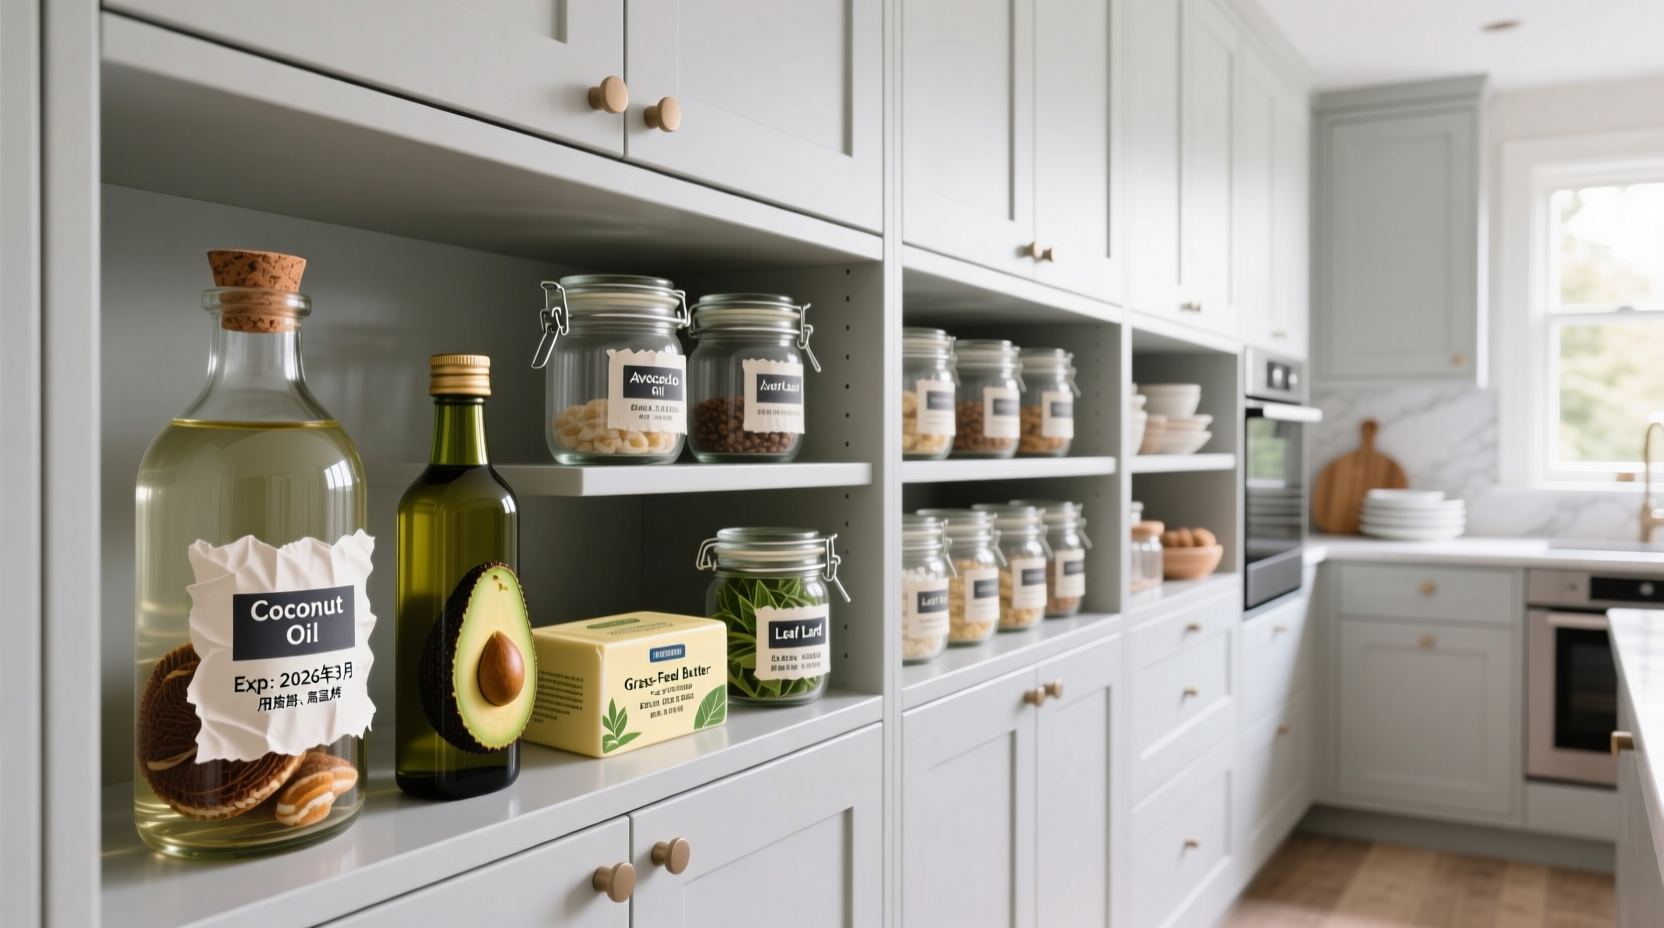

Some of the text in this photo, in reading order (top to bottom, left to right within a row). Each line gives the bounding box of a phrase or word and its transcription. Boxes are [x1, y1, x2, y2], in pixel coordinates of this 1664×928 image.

[250, 595, 344, 622] Coconut
[286, 622, 319, 645] Oil
[234, 661, 353, 695] Exp: 2026年3月
